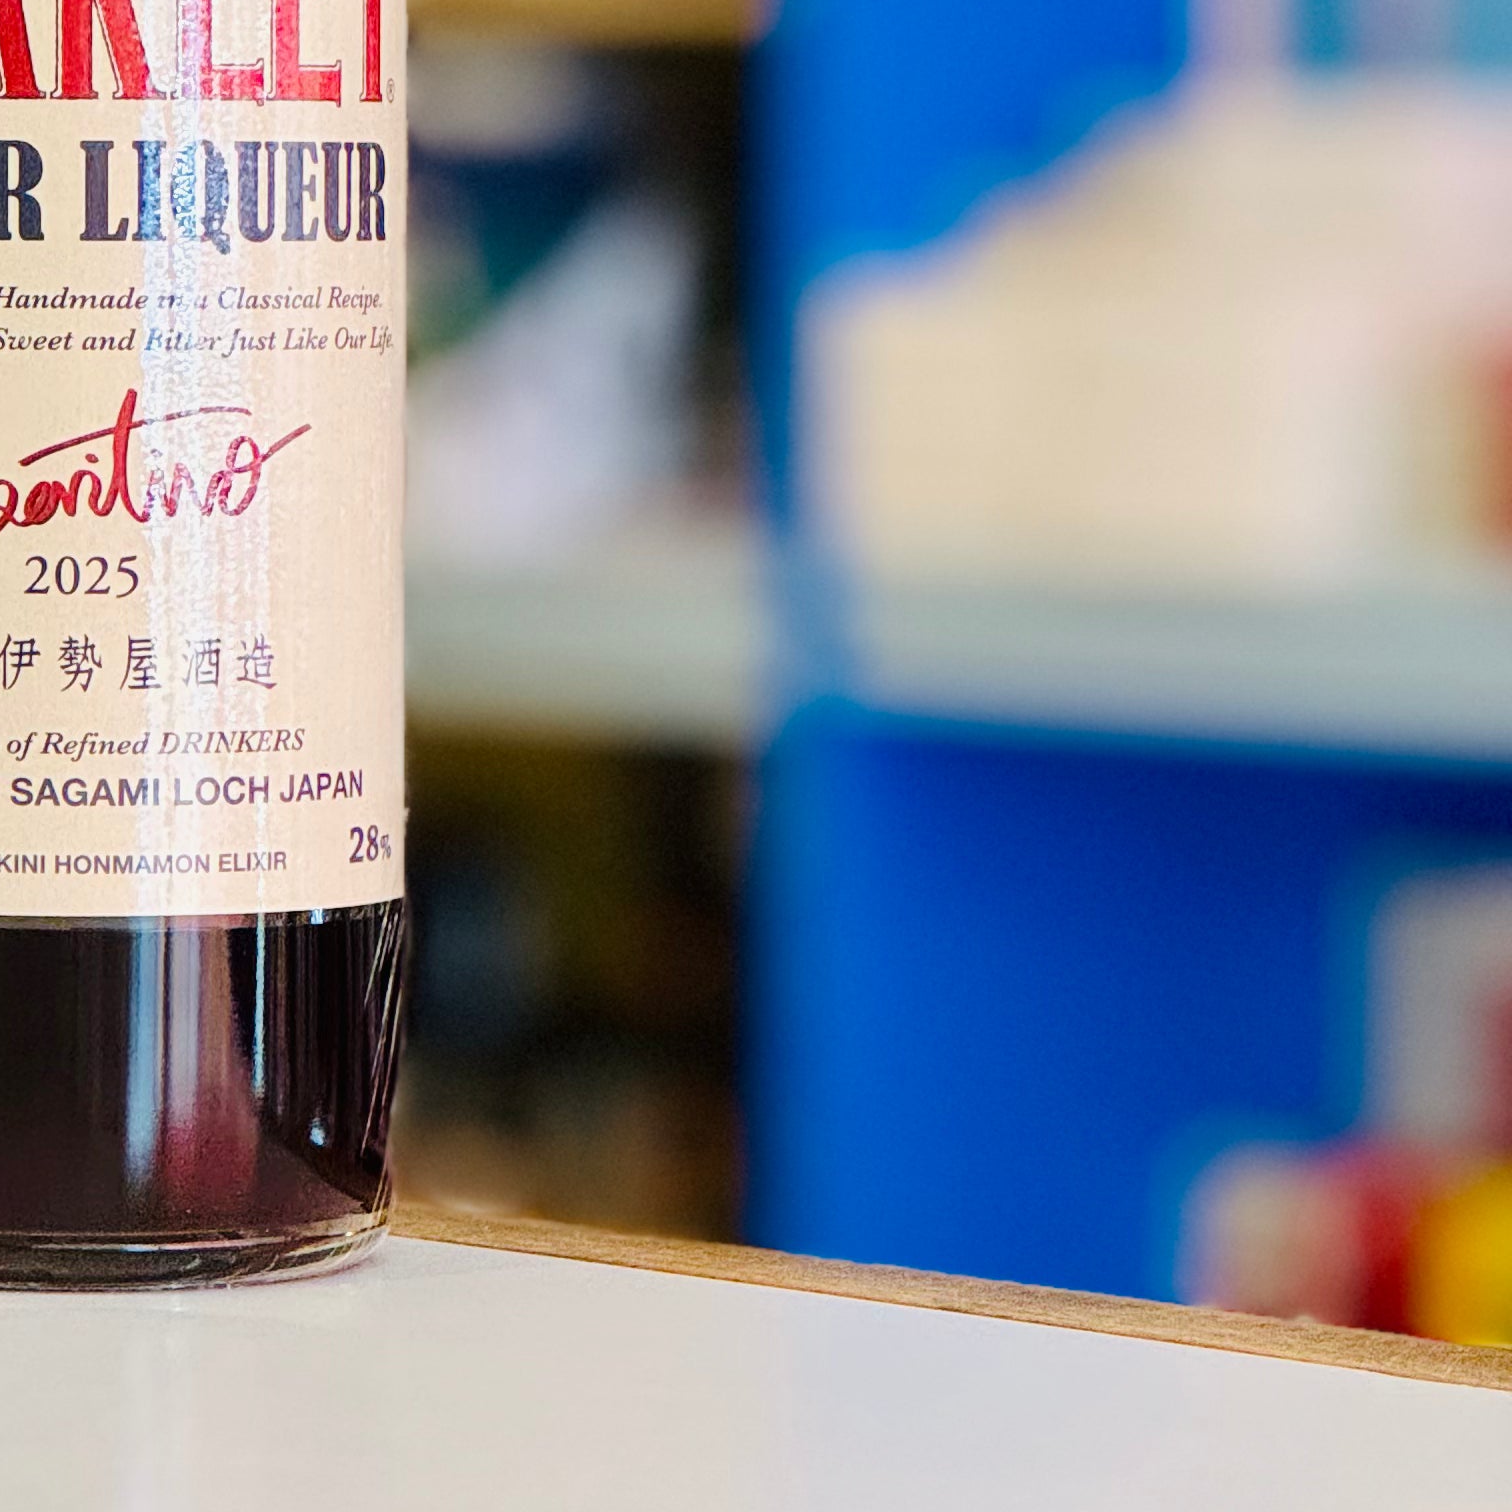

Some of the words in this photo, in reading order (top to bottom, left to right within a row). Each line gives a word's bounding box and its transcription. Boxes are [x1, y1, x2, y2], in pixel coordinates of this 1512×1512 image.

[79, 139, 386, 255] LIQUEUR
[218, 286, 321, 310] Classical
[327, 285, 382, 316] Recipe.
[81, 328, 136, 352] and
[221, 327, 276, 358] Just
[283, 327, 329, 351] Like
[334, 326, 367, 350] Our
[24, 555, 140, 598] 2025
[6, 731, 37, 761] of
[40, 731, 151, 762] Refined
[158, 728, 305, 755] DRINKERS
[10, 777, 160, 807] SAGAMI
[173, 775, 269, 806] LOCH
[280, 769, 363, 803] JAPAN
[349, 825, 392, 863] 28%
[54, 853, 210, 876] HONMAMON
[219, 851, 287, 873] ELIXIR
